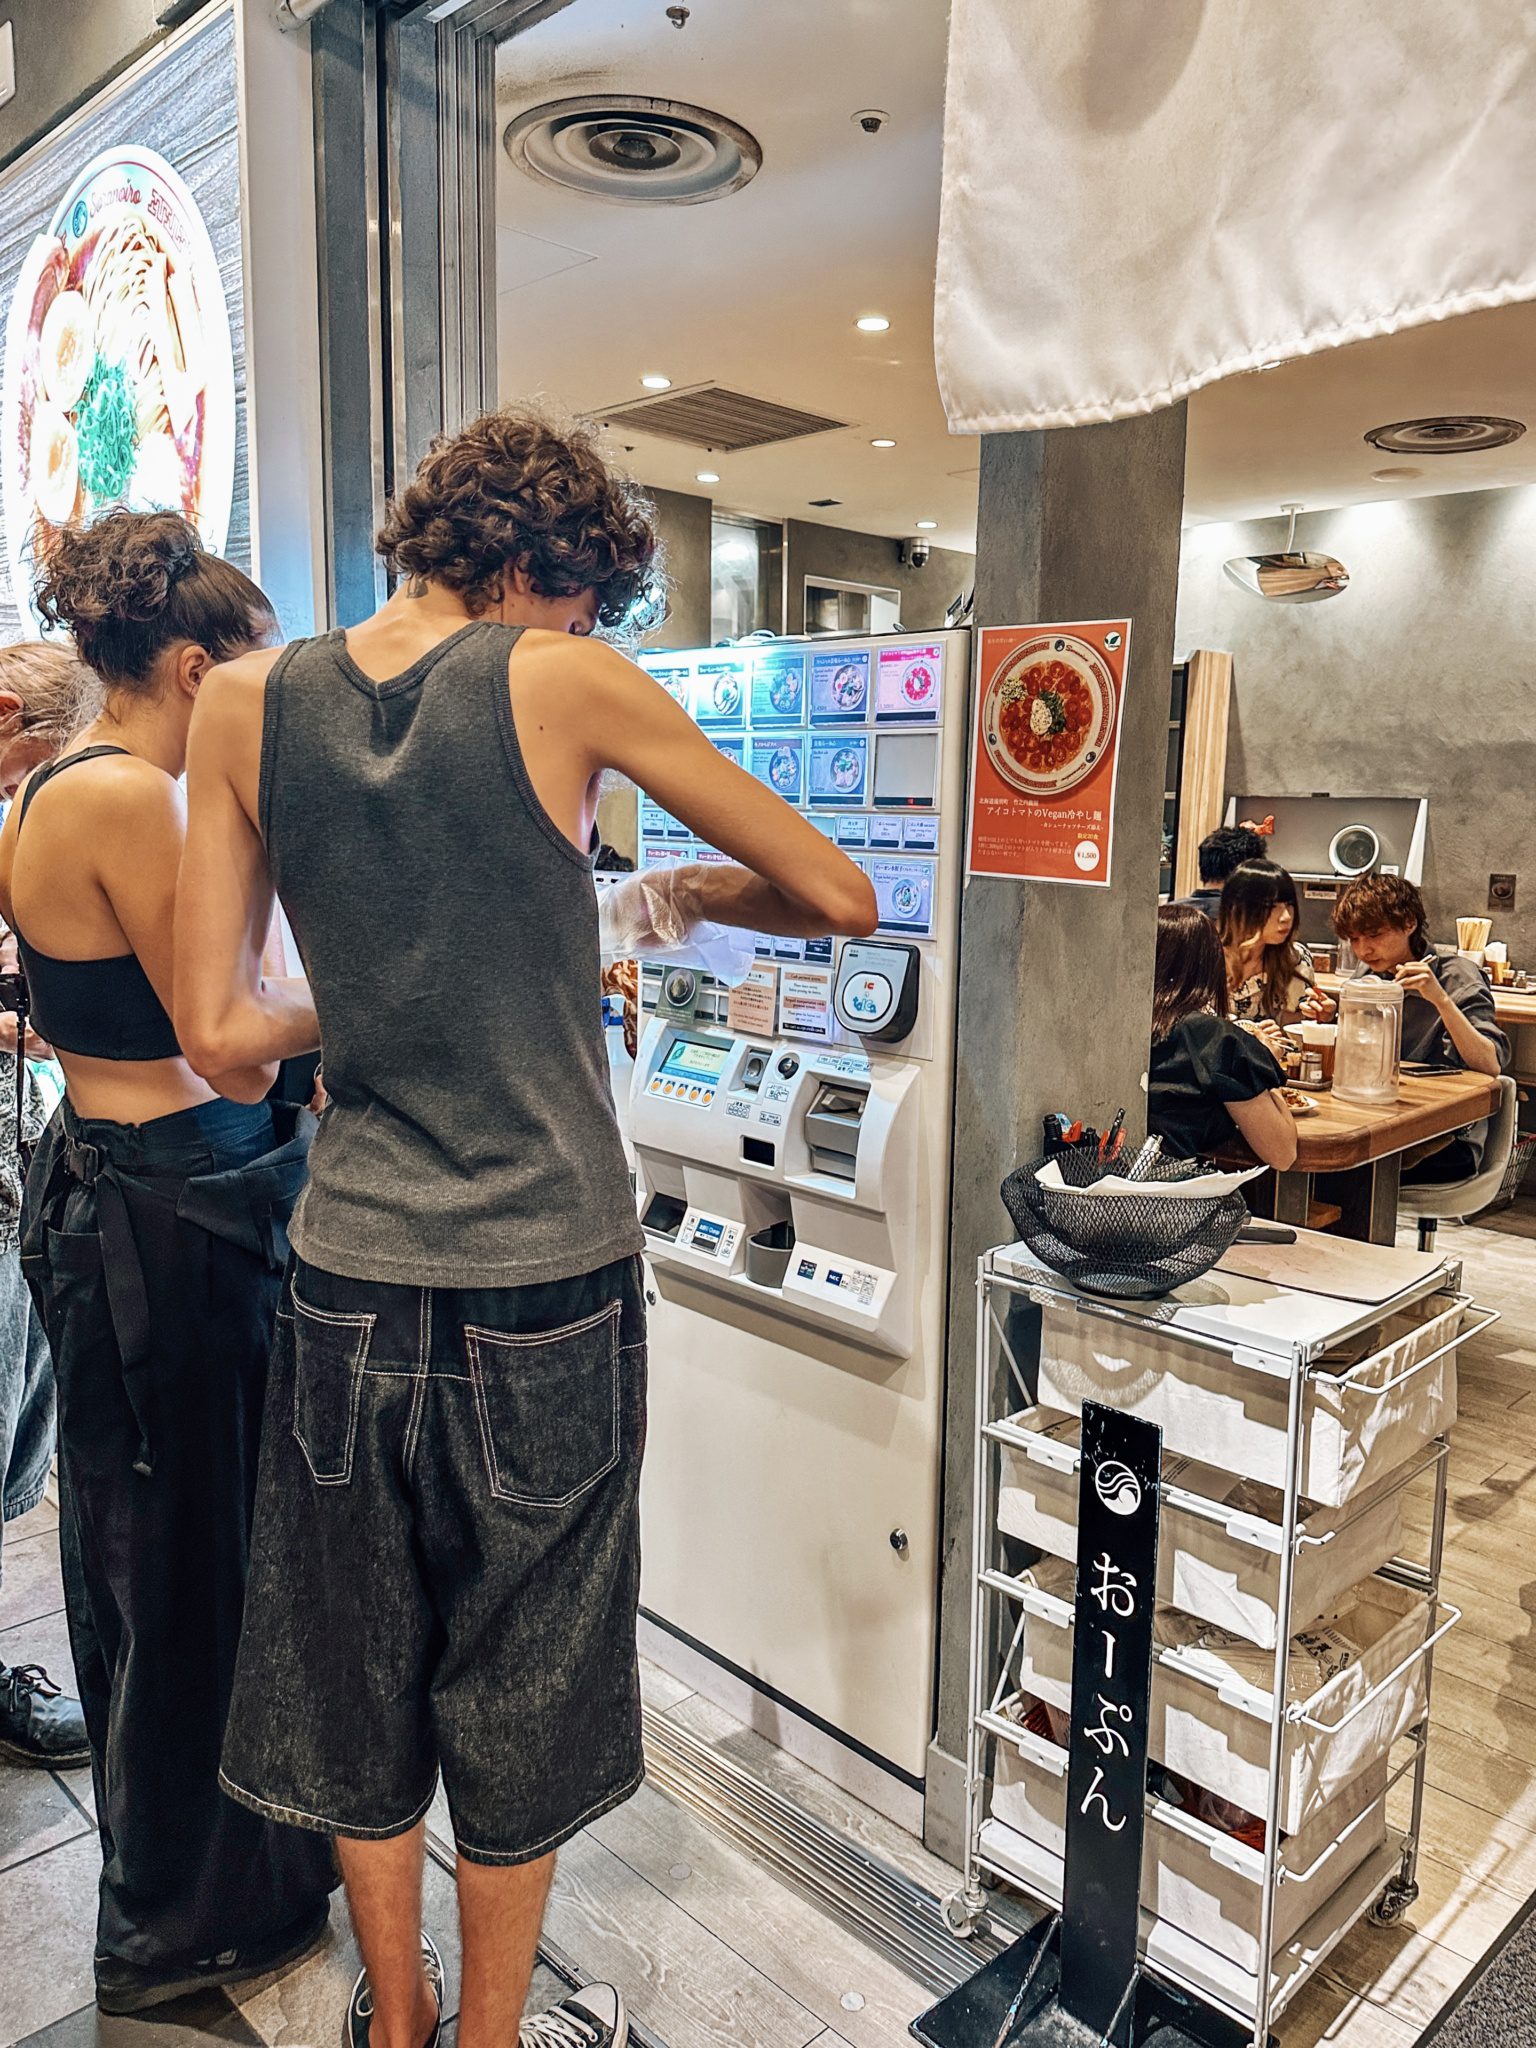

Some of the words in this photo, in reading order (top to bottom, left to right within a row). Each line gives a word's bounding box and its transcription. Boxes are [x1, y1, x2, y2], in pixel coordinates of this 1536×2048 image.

[864, 981, 875, 990] IC
[829, 1274, 840, 1282] NEC
[1080, 1552, 1137, 1832] おーぷん
